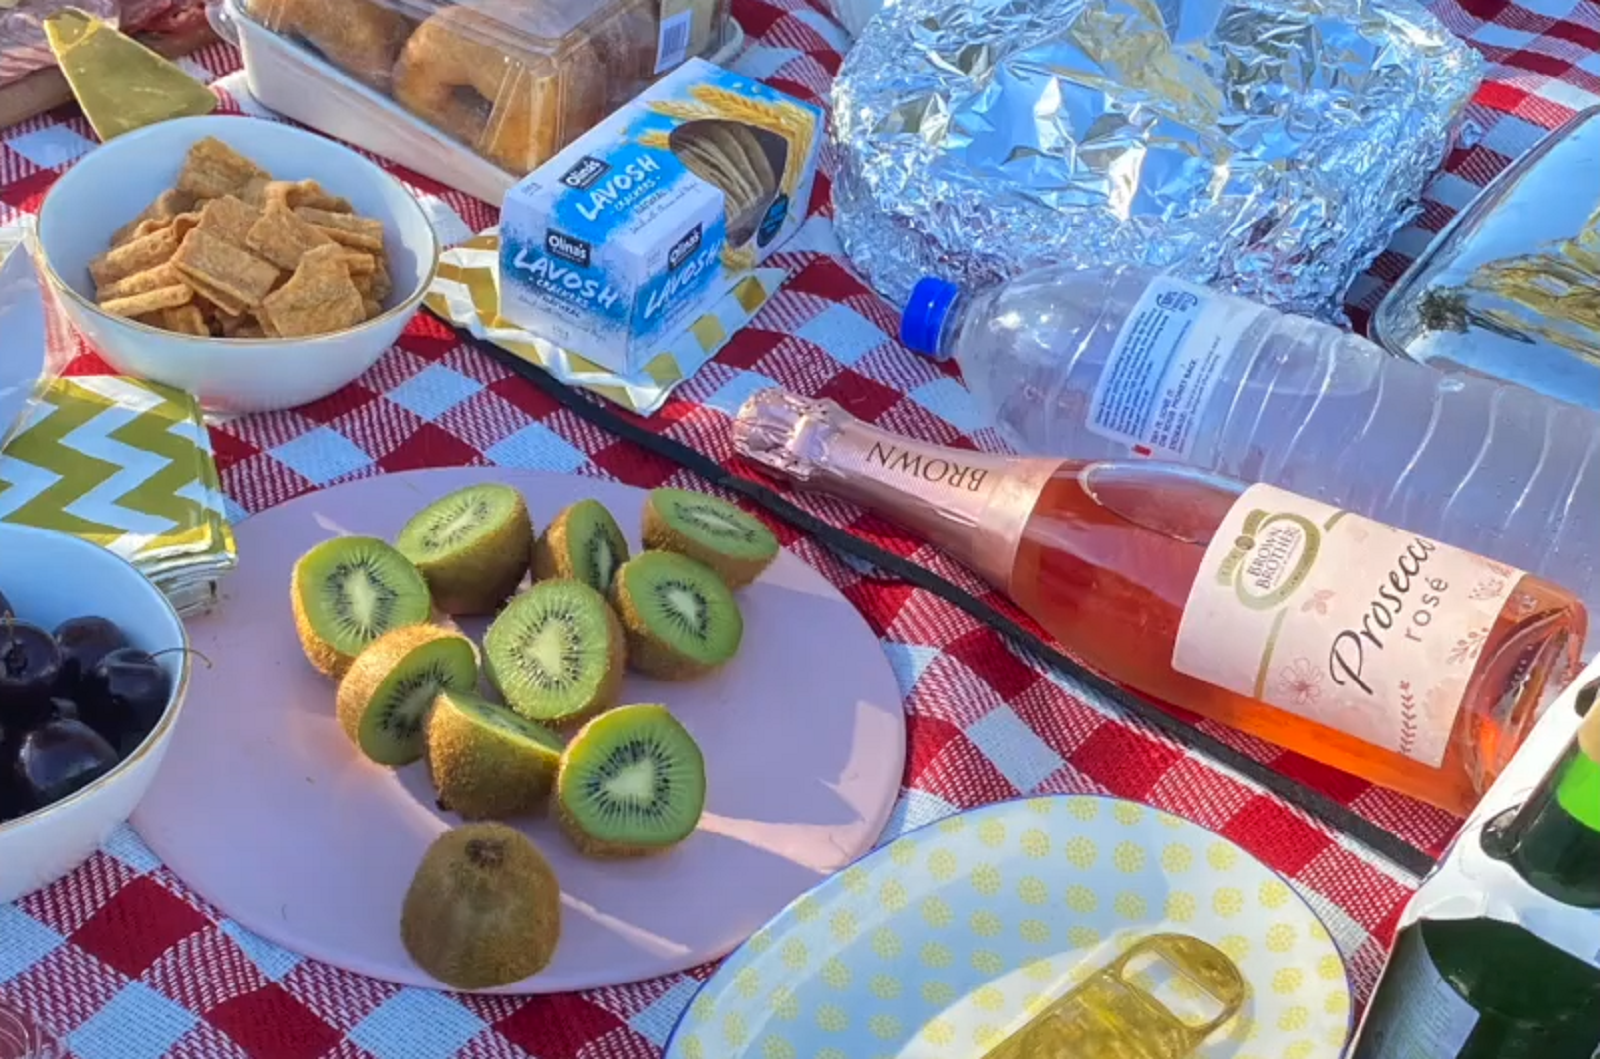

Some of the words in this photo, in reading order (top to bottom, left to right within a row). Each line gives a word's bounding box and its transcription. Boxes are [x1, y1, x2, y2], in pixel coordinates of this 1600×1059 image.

[566, 160, 601, 186] Olina's
[575, 153, 661, 222] LAVOSH
[549, 235, 587, 259] Olina's
[513, 247, 619, 310] LAVOSH
[643, 240, 722, 319] LAVOSH
[866, 440, 989, 493] BROWN
[1246, 527, 1284, 577] BROWN
[1404, 576, 1449, 643] rosé
